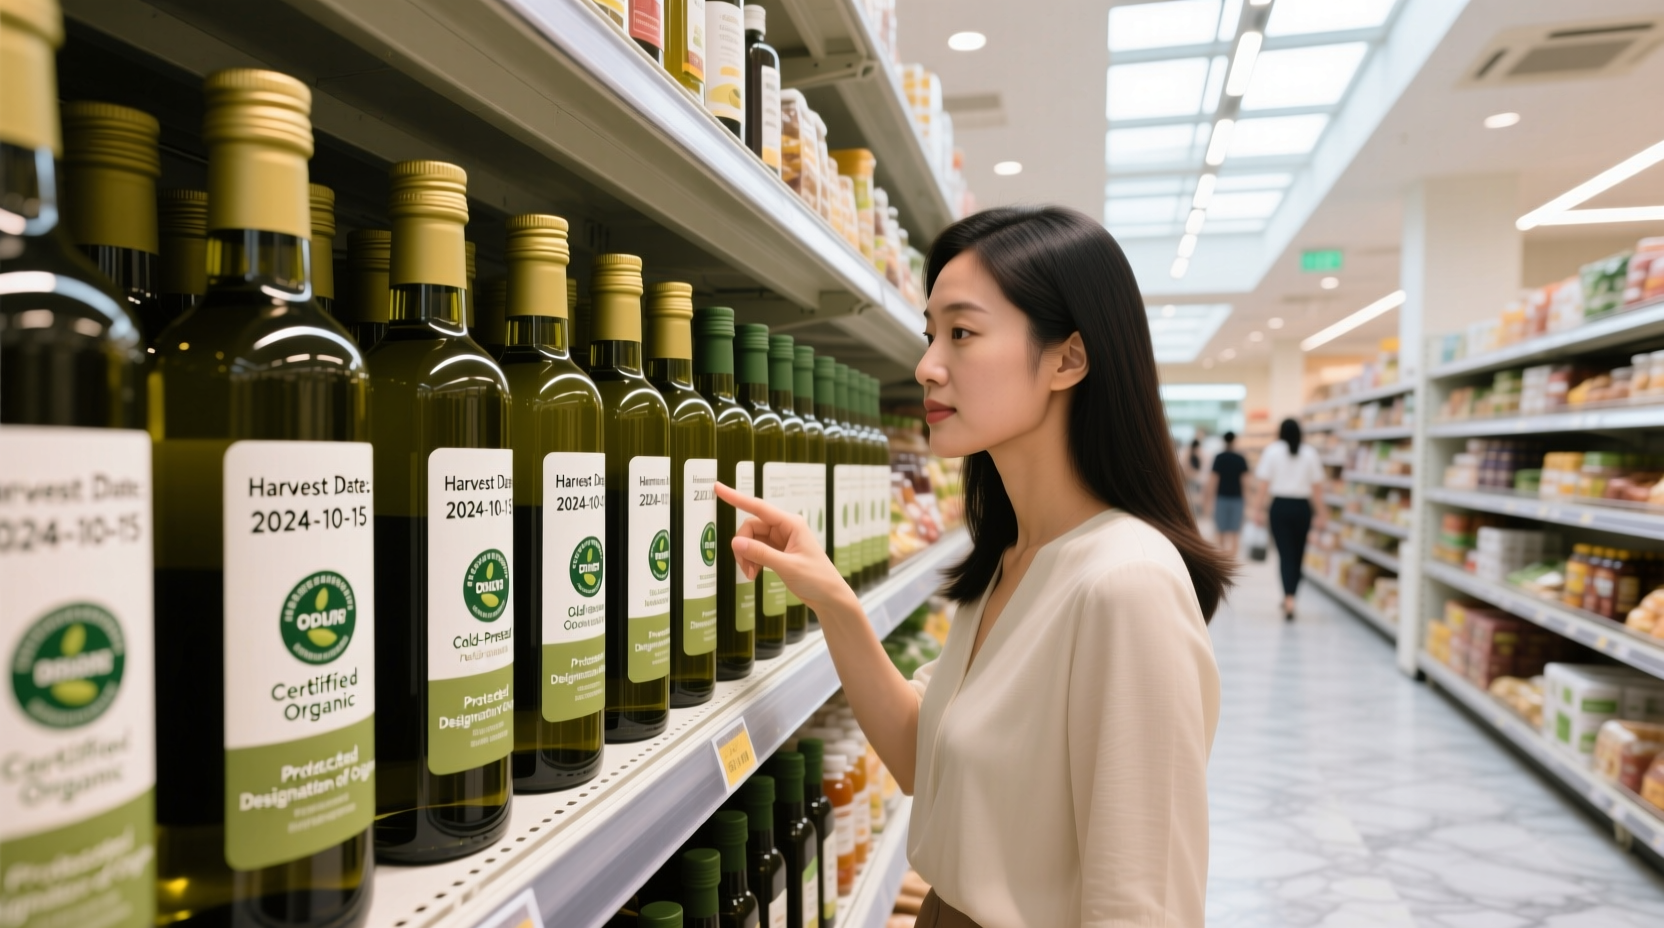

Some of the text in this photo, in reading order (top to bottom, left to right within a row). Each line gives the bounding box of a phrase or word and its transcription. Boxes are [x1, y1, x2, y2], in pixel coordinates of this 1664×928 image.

[249, 475, 370, 497] Harvest Date:
[445, 475, 495, 491] Harvest
[251, 505, 367, 534] 2024-10-15
[284, 692, 356, 722] Organic
